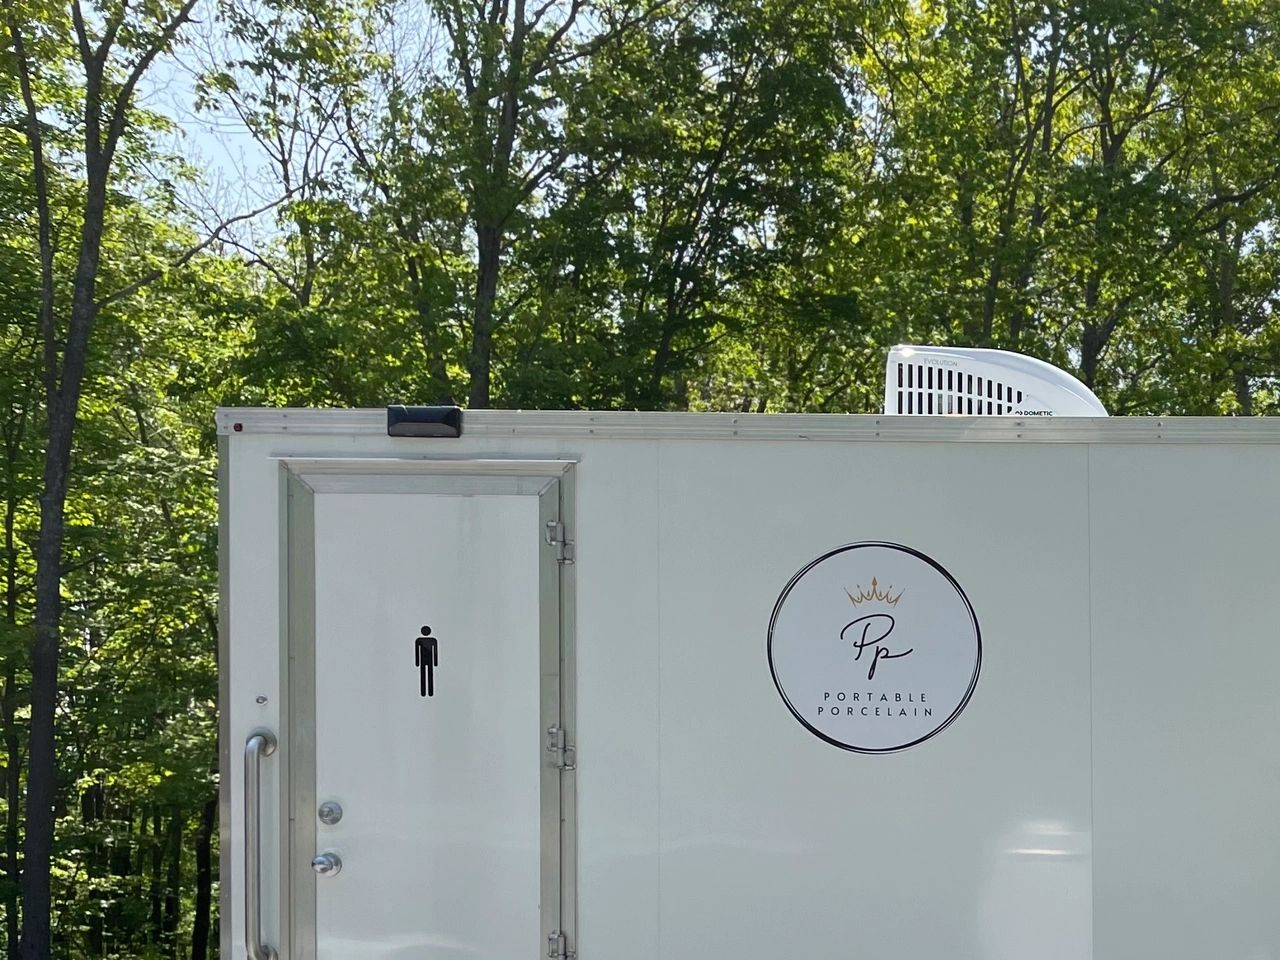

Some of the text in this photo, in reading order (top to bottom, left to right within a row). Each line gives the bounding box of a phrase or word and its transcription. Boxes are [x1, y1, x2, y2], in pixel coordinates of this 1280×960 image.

[840, 613, 914, 681] Pp
[824, 692, 926, 702] PORTABLE
[817, 706, 932, 717] PORCELAIN
